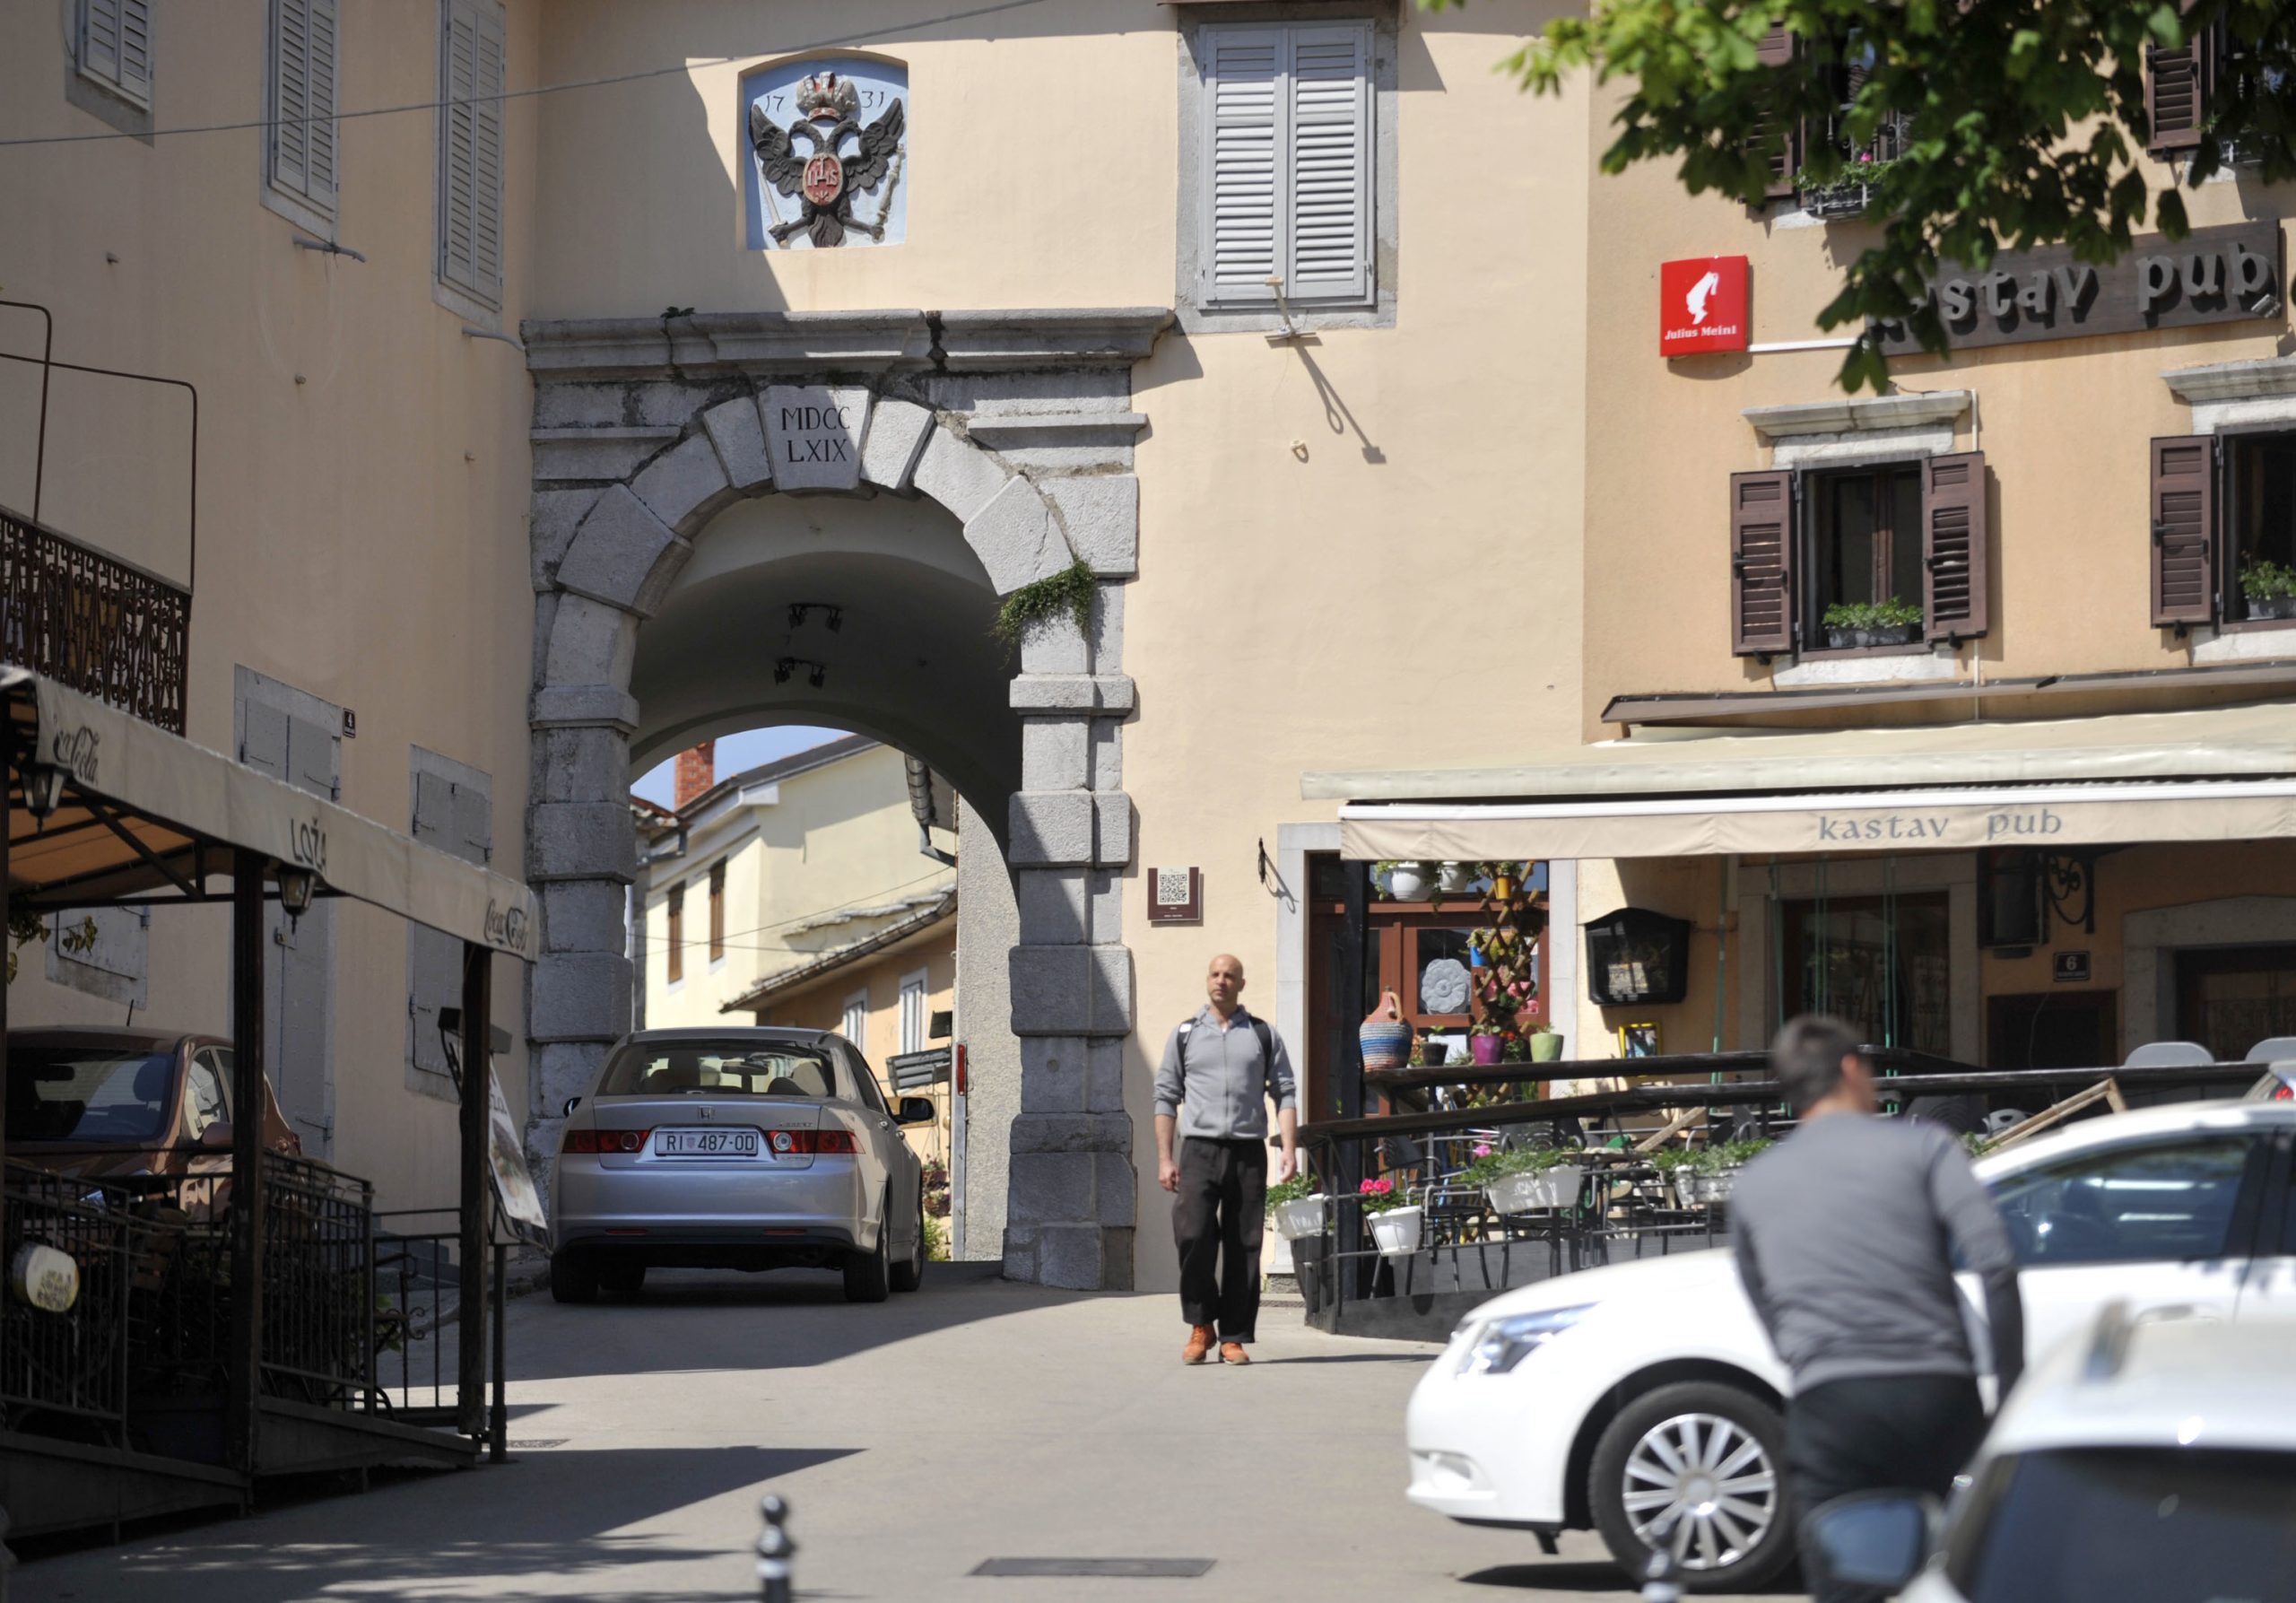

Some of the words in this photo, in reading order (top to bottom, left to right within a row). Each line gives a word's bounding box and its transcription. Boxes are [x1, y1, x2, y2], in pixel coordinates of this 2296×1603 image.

[2135, 240, 2270, 314] pub
[1665, 327, 1699, 341] Julius
[1701, 325, 1737, 336] Meinl
[781, 406, 851, 431] MDCC
[787, 438, 848, 463] LXIX
[1818, 815, 1950, 841] kastav
[1987, 808, 2063, 841] pub
[2066, 955, 2077, 971] 6
[666, 1135, 683, 1151] RI
